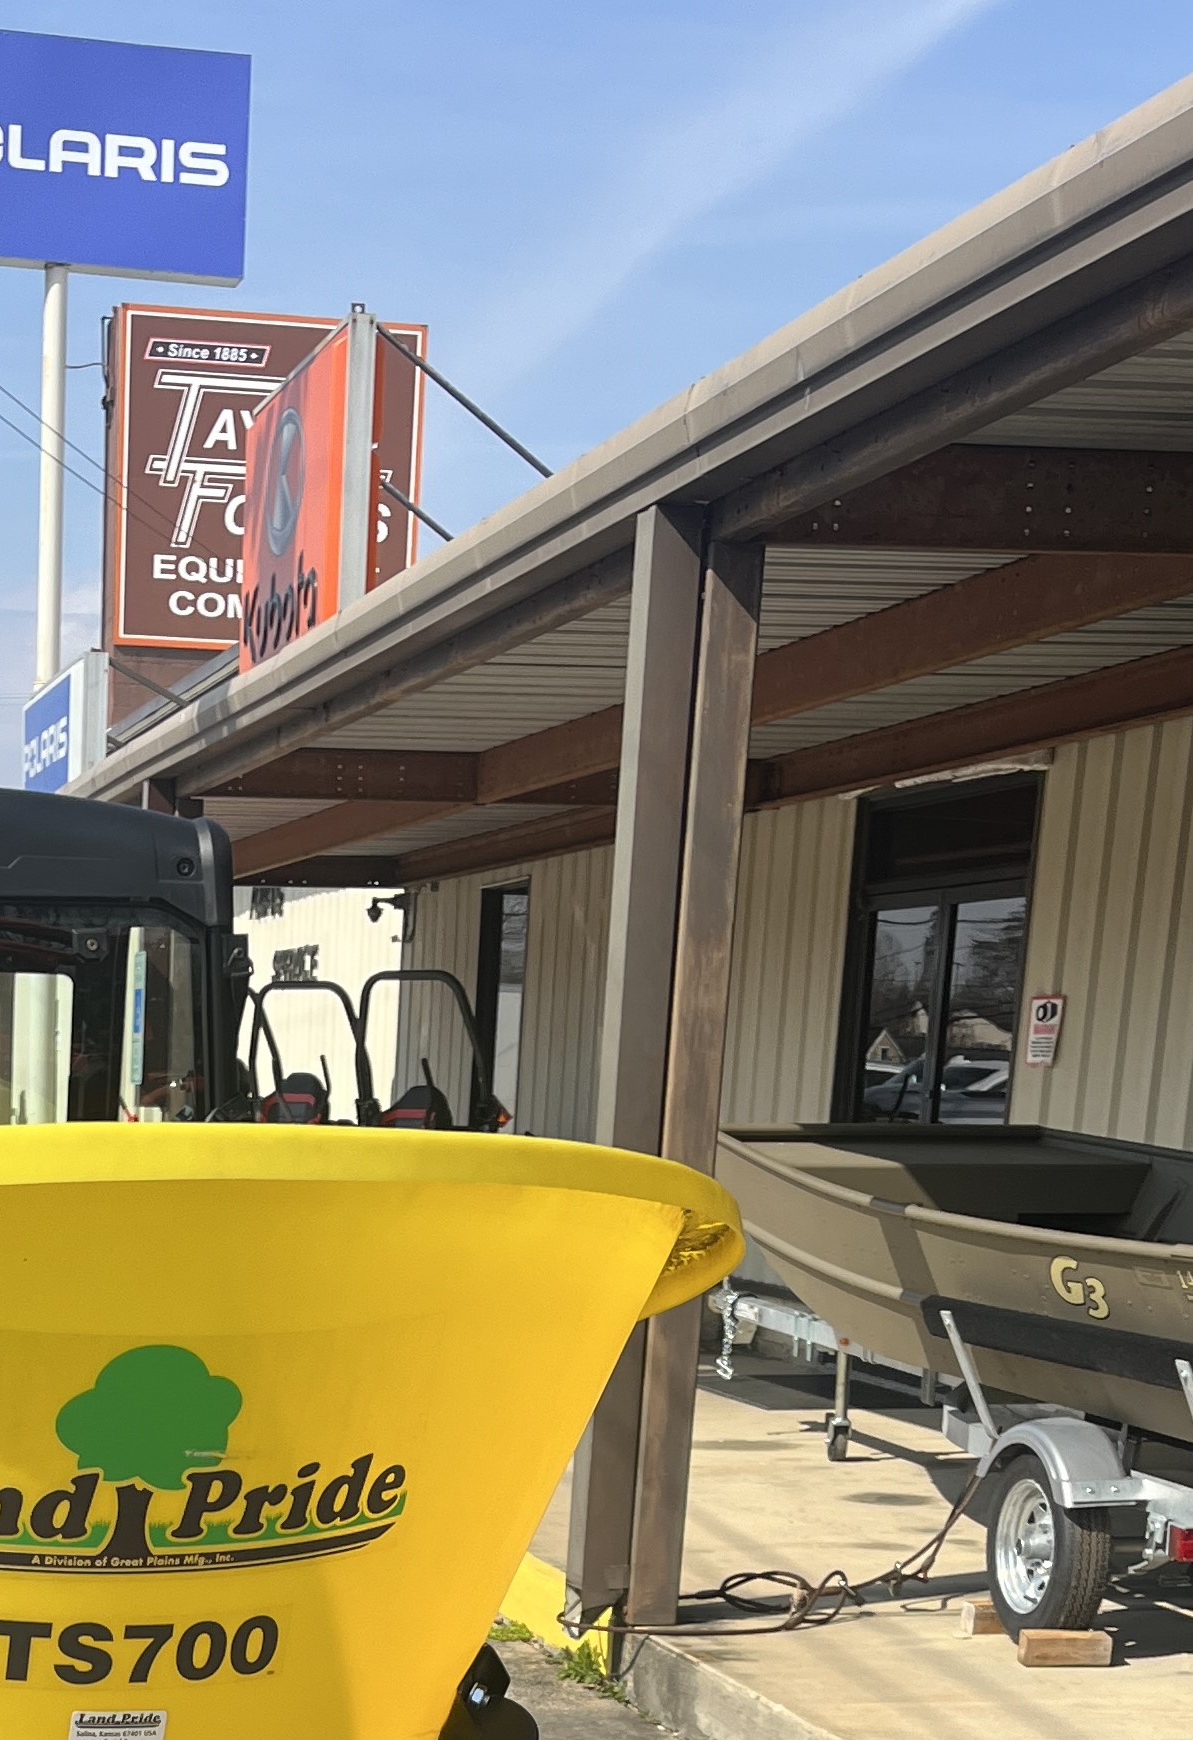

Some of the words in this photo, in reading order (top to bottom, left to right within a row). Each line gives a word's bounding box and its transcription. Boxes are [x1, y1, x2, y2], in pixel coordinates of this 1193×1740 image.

[168, 344, 210, 360] Since
[214, 347, 247, 362] 1885
[1049, 1255, 1110, 1320] G3
[170, 1453, 406, 1540] Pride
[31, 1555, 41, 1565] A
[44, 1556, 91, 1567] Division
[95, 1556, 107, 1567] of
[110, 1557, 144, 1567] Great
[146, 1555, 180, 1566] Plains
[215, 1553, 235, 1563] Inc.
[78, 1713, 117, 1725] Land
[118, 1713, 161, 1725] Pride
